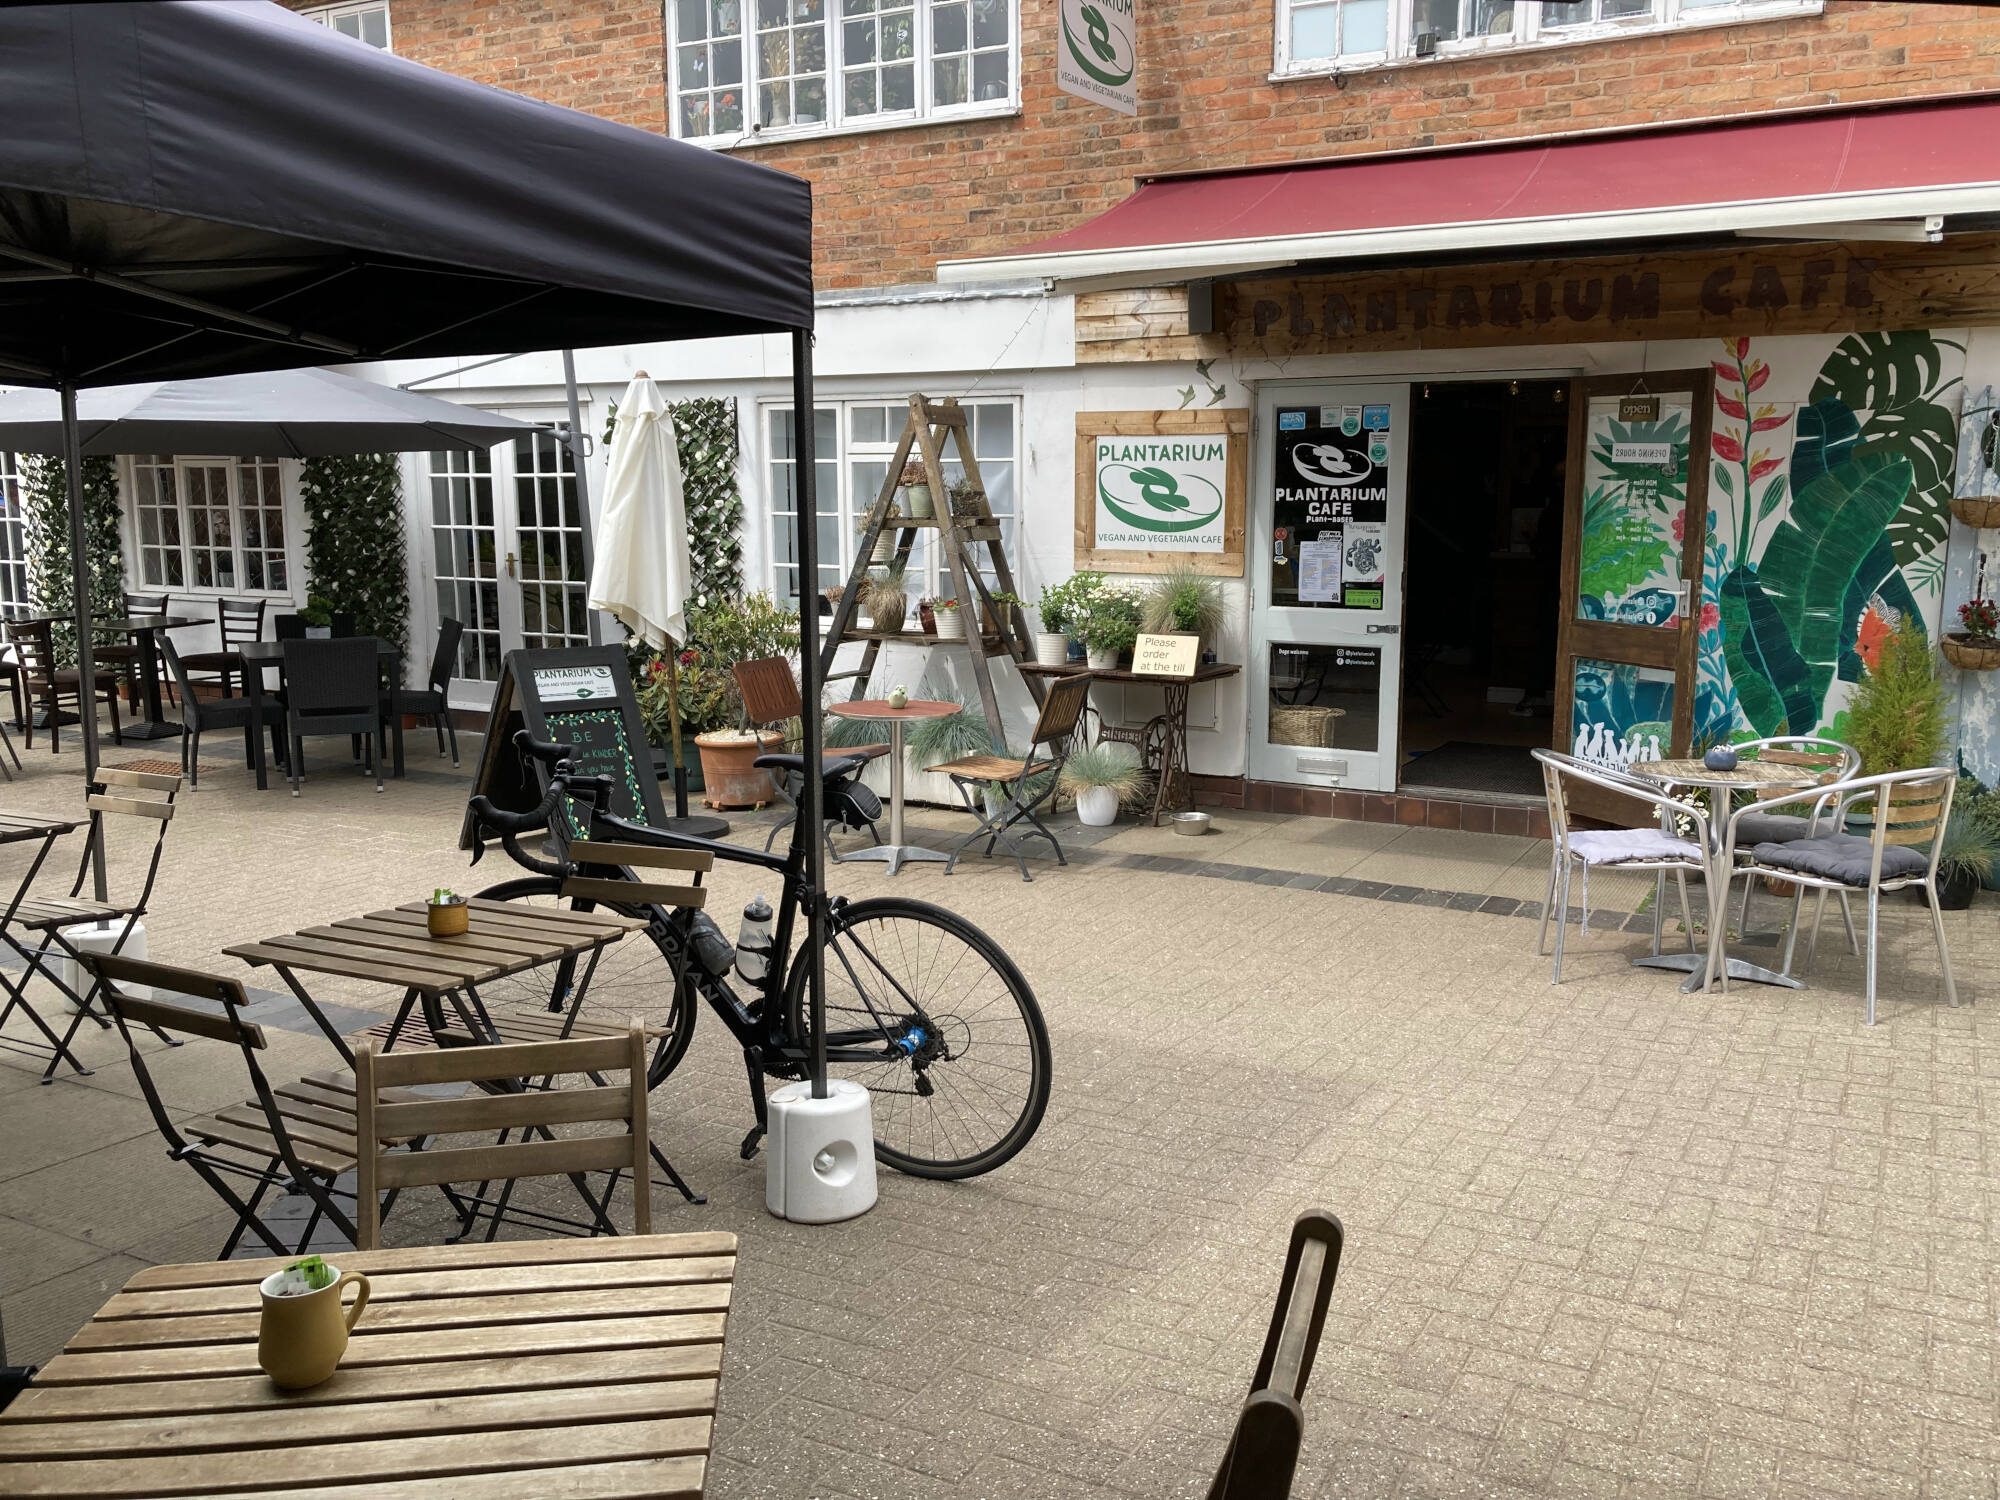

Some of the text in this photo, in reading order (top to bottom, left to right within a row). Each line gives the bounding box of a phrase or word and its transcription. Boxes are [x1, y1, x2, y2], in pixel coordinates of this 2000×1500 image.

[1060, 70, 1135, 106] VEGAN AND VEGETARIAN CAFE
[1253, 256, 1878, 338] PLANTARIUM CAFE
[1623, 404, 1651, 416] open
[1098, 443, 1224, 462] PLANTARIUM
[1275, 486, 1386, 502] PLANTARIUM
[1308, 502, 1352, 516] CAFE
[1098, 533, 1222, 544] VEGAN AND VEGETARIAN CAFE
[1145, 637, 1177, 648] Please
[1142, 650, 1169, 659] order
[1140, 662, 1186, 672] at the till
[533, 668, 592, 680] PLANTARIUM
[572, 731, 593, 743] BE
